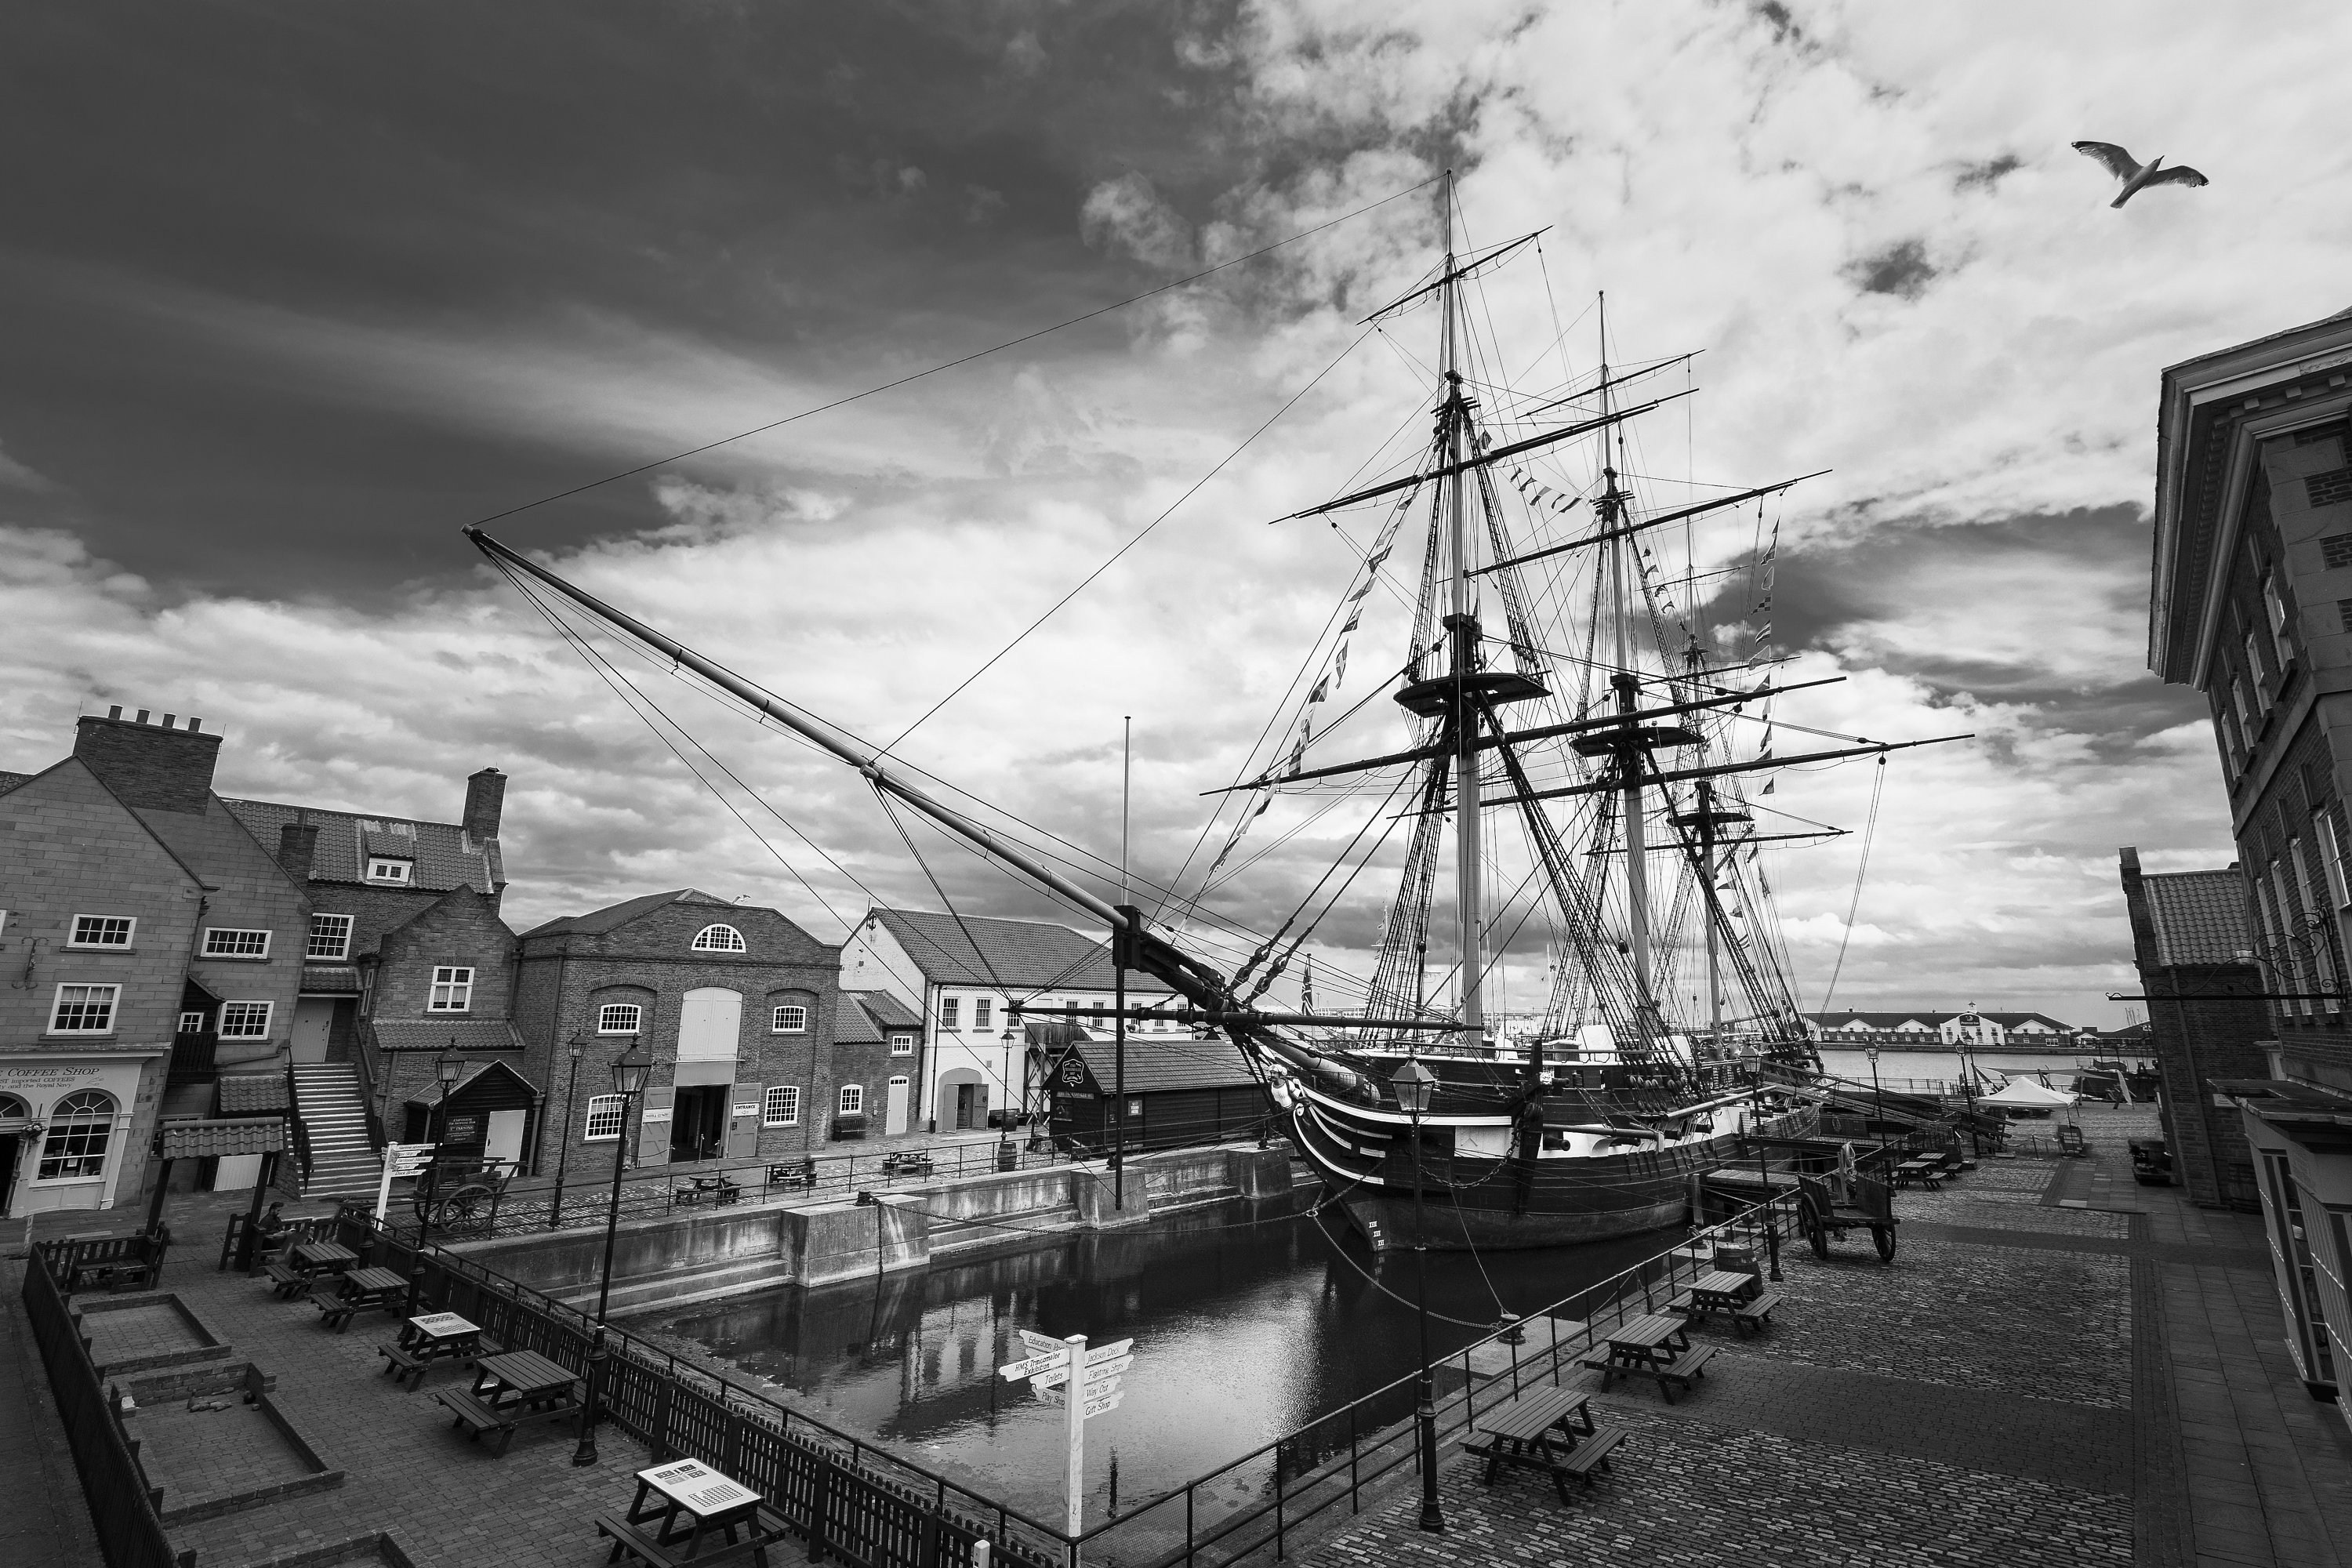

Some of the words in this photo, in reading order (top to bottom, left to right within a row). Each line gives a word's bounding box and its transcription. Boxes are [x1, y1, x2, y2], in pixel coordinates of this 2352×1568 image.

[8, 1068, 59, 1077] COFFEE
[63, 1067, 100, 1076] SHOP
[1029, 1336, 1051, 1349] Education
[1014, 1361, 1029, 1372] HMS
[1029, 1352, 1061, 1367] Trincomalee
[1087, 1352, 1106, 1365] Jackson
[1107, 1346, 1120, 1356] Dock
[1024, 1363, 1050, 1376] Exhibition
[1088, 1367, 1109, 1380] Fighting
[1110, 1363, 1123, 1373] Ships
[1045, 1373, 1063, 1385] Toilets
[1041, 1392, 1054, 1404] Play
[1087, 1387, 1098, 1398] Way
[1099, 1385, 1109, 1393] Out
[1085, 1405, 1096, 1416] Gift
[1098, 1401, 1111, 1411] Shop
